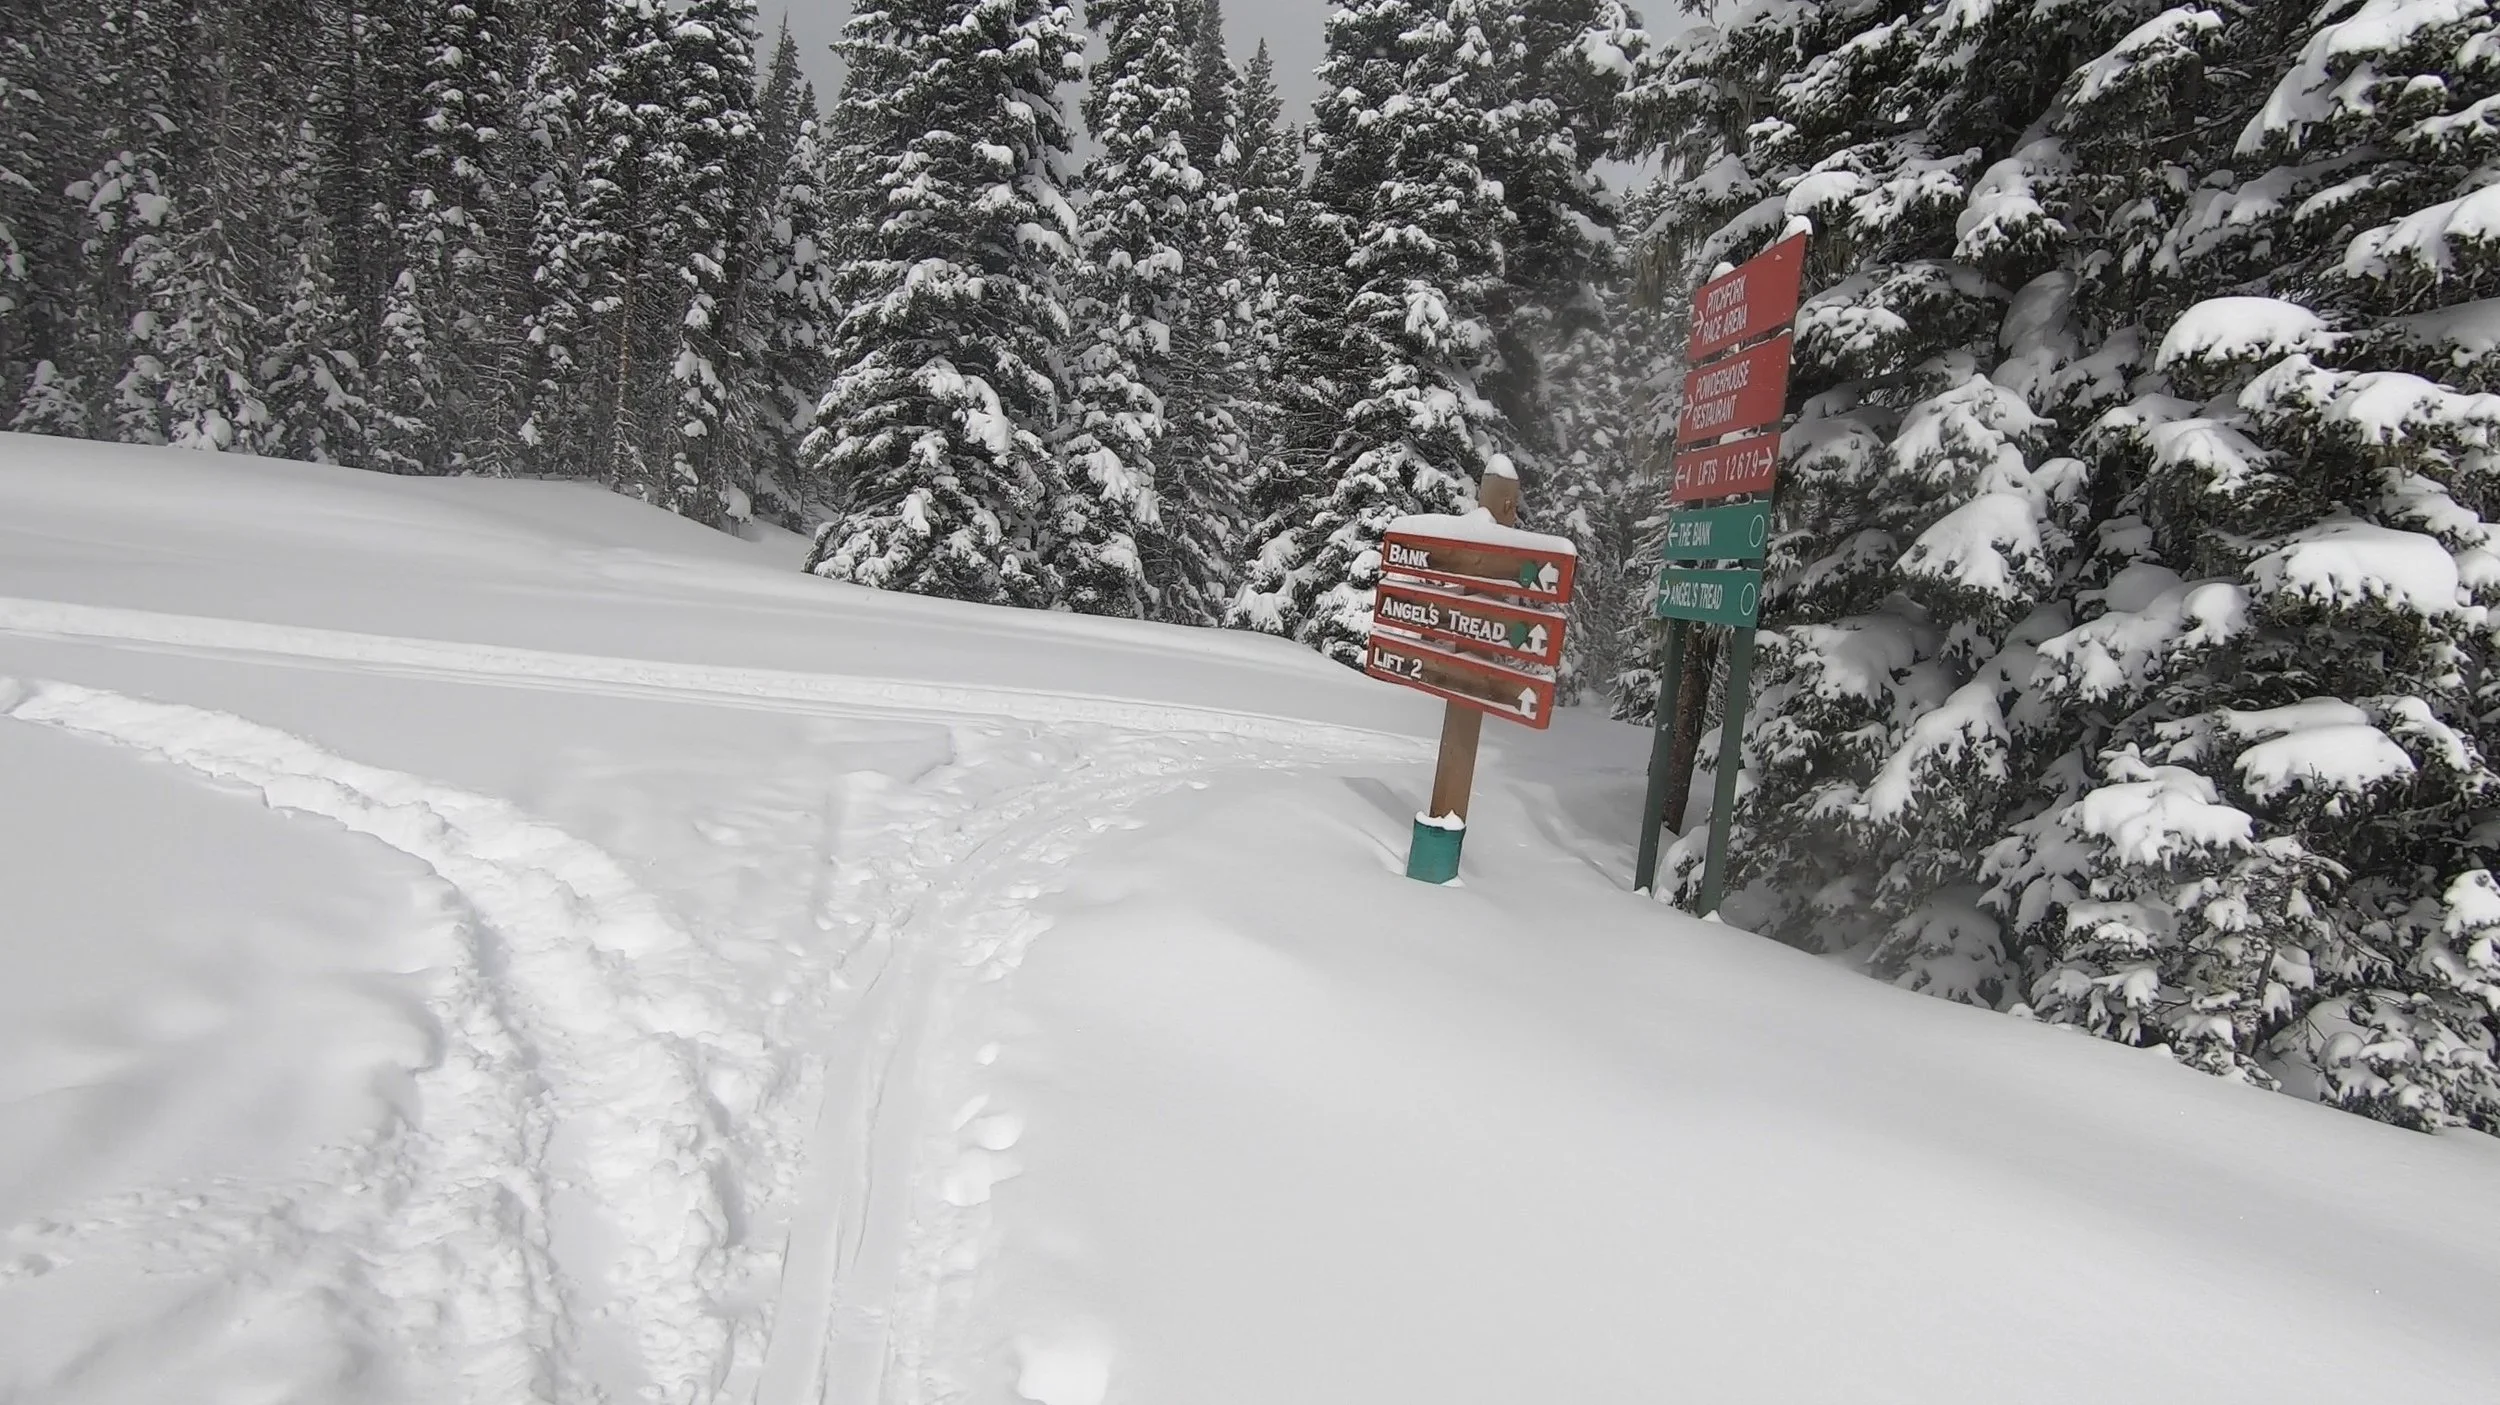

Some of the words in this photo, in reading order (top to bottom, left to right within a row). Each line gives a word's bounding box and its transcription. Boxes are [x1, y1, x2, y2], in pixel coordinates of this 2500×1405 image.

[1705, 274, 1747, 317] PITCHFORK
[1702, 315, 1722, 345] RACE
[1722, 304, 1747, 338] ARENA
[1695, 360, 1750, 402] POWDERHOUSE
[1691, 394, 1737, 431] RESTAURANT
[1697, 458, 1718, 486] LIFTS
[1678, 522, 1692, 546] THE
[1692, 521, 1712, 546] BANK
[1389, 544, 1430, 567] BANK
[1670, 581, 1699, 608] ANGEL'S
[1699, 582, 1723, 610] TREAD
[1381, 597, 1440, 625] ANGEL'S
[1449, 609, 1506, 641] TREAD
[1373, 647, 1405, 673] LIFT
[1410, 658, 1423, 679] 2
